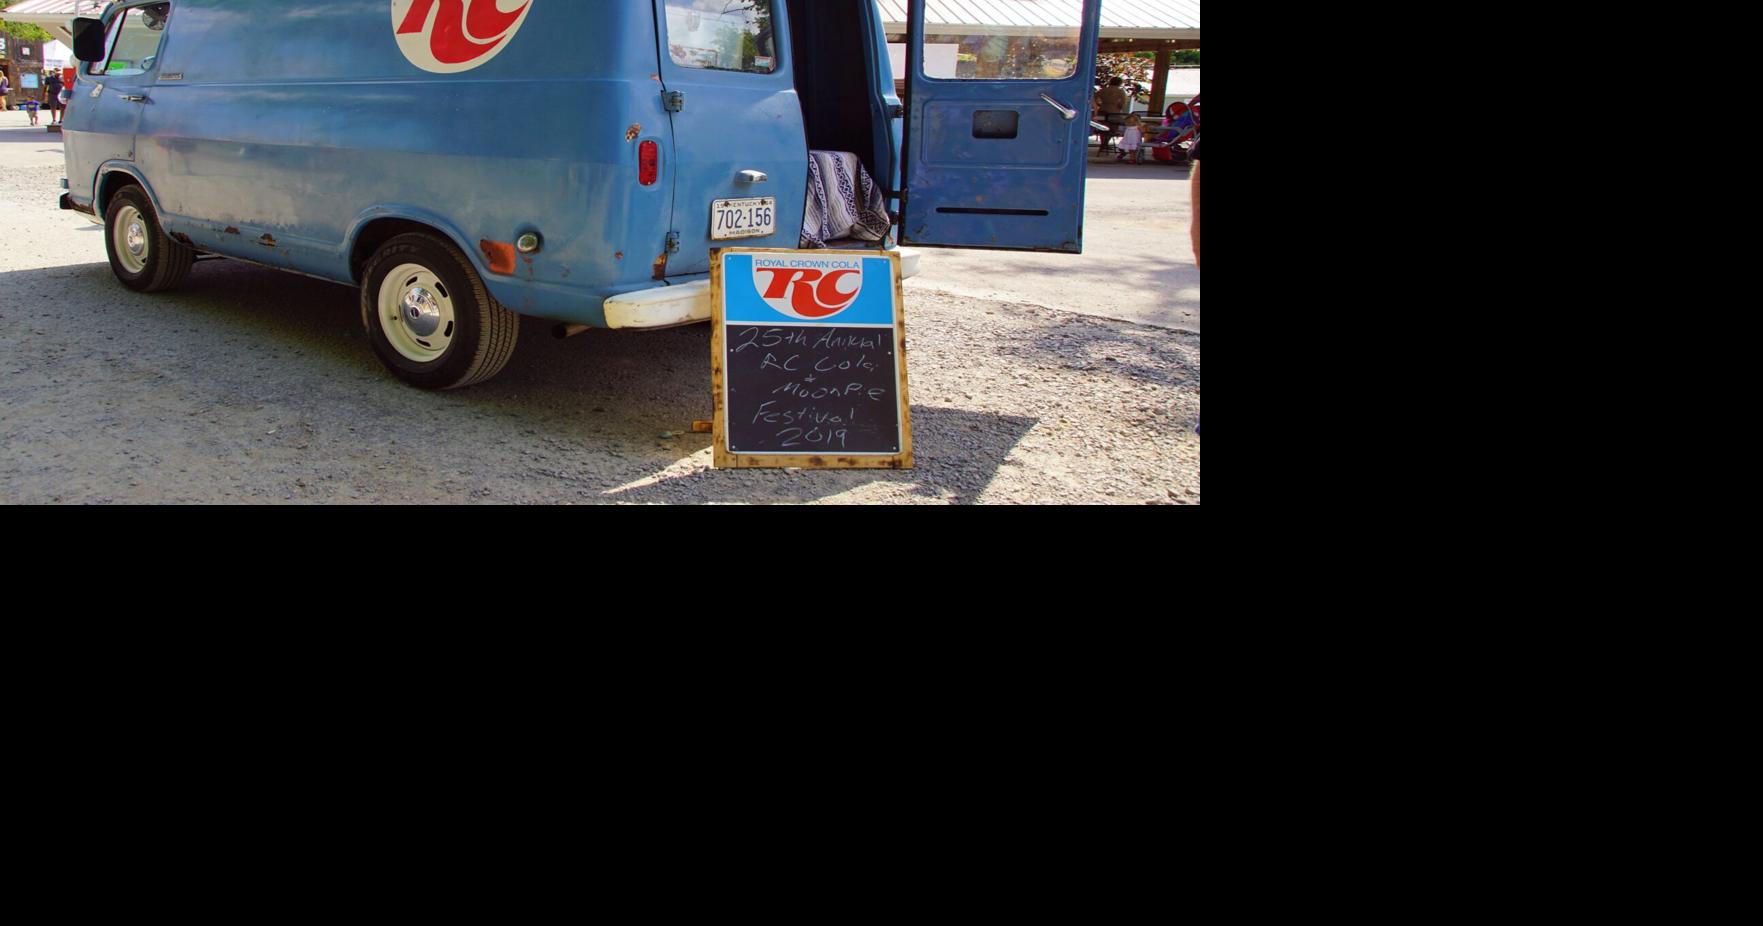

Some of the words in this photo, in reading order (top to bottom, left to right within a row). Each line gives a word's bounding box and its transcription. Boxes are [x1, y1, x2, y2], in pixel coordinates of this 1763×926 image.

[755, 259, 788, 267] ROYAL
[790, 259, 829, 268] CROWN
[831, 260, 859, 269] COLA
[756, 267, 860, 318] RC
[736, 326, 807, 352] 25th
[760, 352, 800, 371] RC
[752, 400, 854, 425] Festival
[776, 426, 849, 449] 2019
